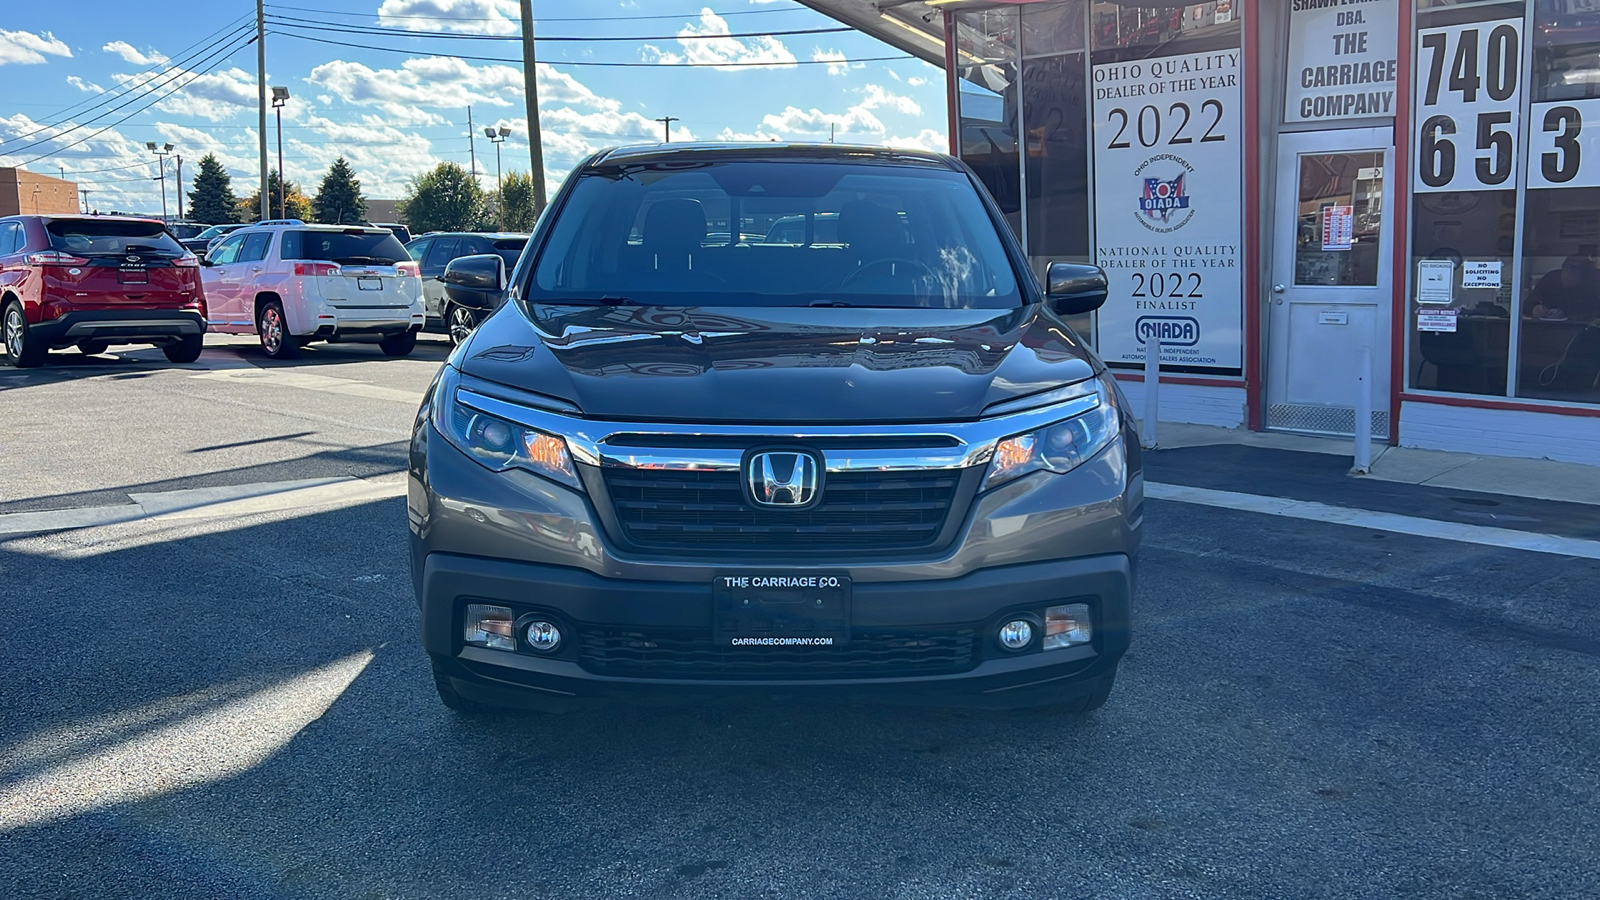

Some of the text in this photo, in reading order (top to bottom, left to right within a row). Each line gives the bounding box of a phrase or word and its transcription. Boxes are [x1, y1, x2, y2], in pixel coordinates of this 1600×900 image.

[1336, 10, 1366, 26] DBA.
[1332, 31, 1368, 56] THE
[1094, 53, 1239, 83] OHIO QUALITY
[1301, 59, 1396, 89] CARRIAGE
[1422, 24, 1519, 106] 740
[1096, 74, 1236, 100] DEALER OF THE YEAR
[1300, 91, 1393, 119] COMPANY
[1107, 99, 1226, 149] 2022
[1134, 154, 1195, 177] OHIO INDEPENDENT
[1145, 198, 1181, 209] OIADA
[1099, 245, 1237, 257] NATIONAL QUALITY
[1101, 259, 1235, 268] DEALER OF THE YEAR
[1131, 272, 1203, 298] 2022
[1136, 301, 1196, 310] FINALIST
[1140, 322, 1193, 339] NIADA
[724, 577, 841, 588] THE CARRIAGE CO.
[731, 638, 833, 646] CARRIAGECOMPANY.COM
